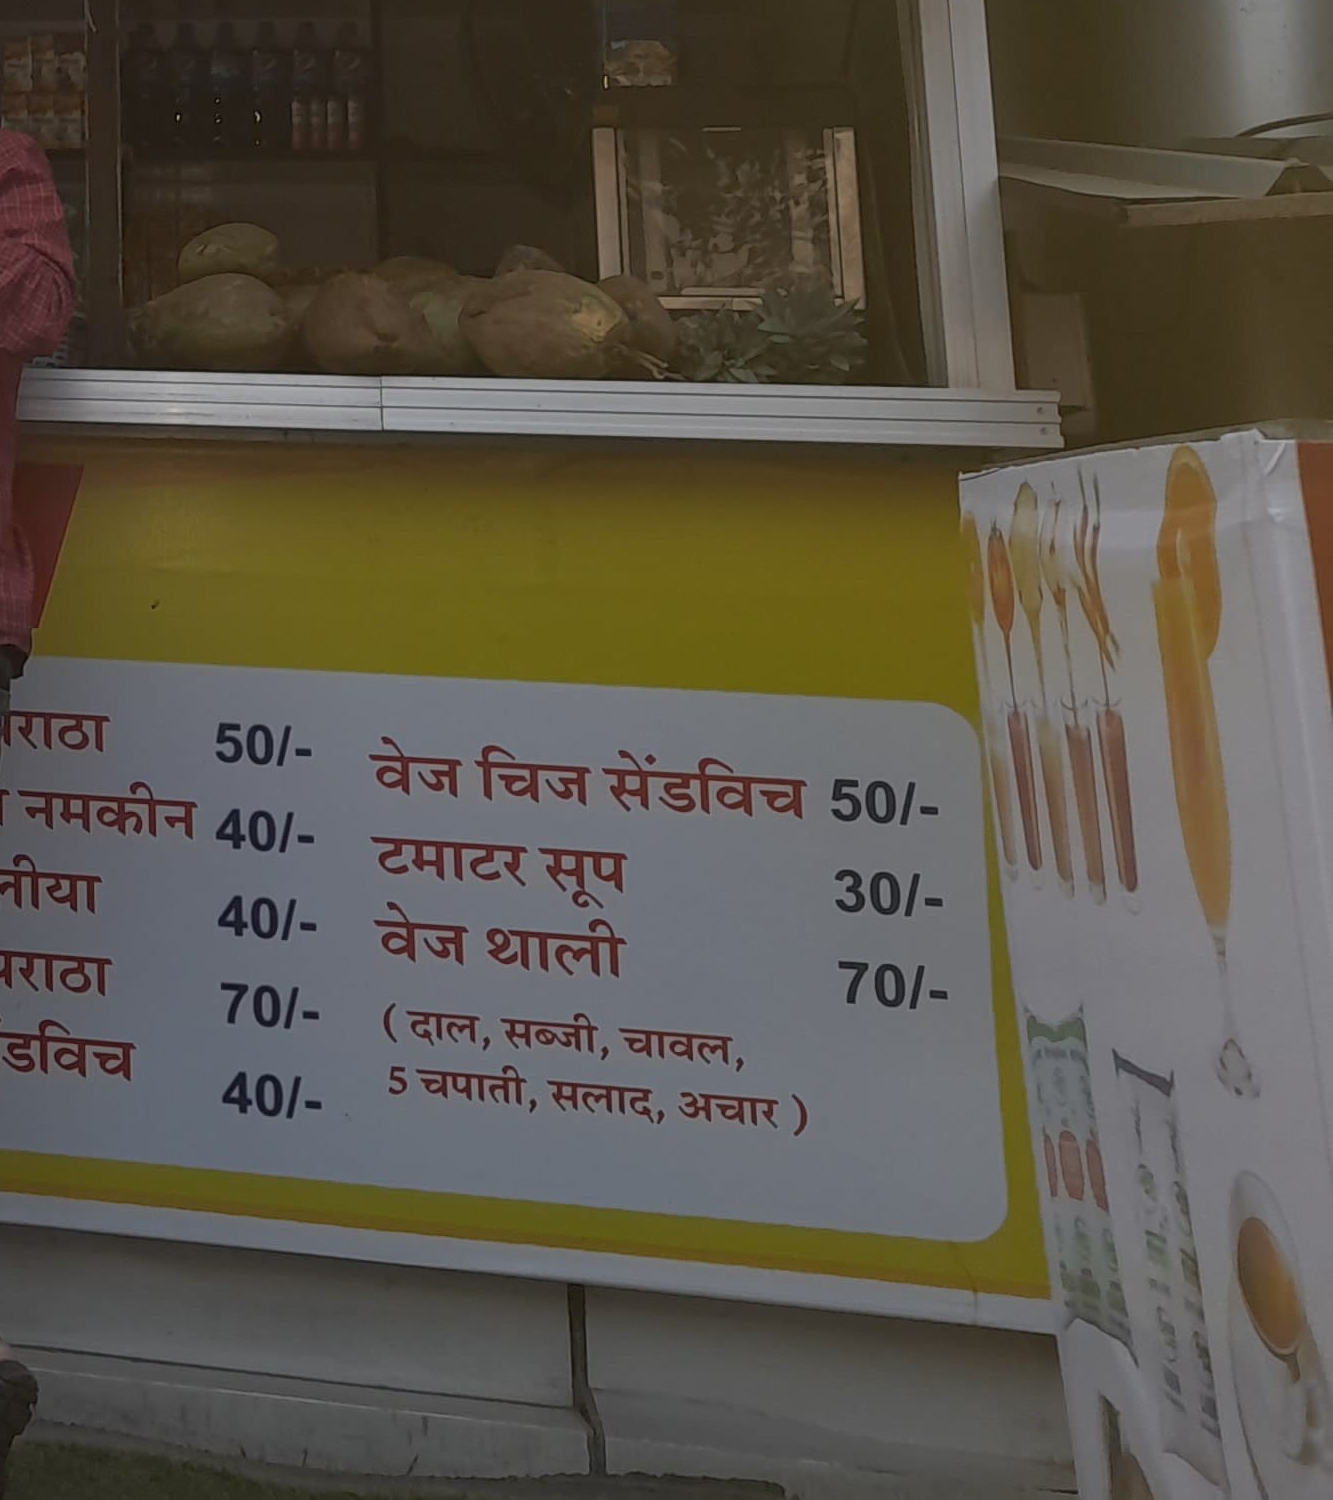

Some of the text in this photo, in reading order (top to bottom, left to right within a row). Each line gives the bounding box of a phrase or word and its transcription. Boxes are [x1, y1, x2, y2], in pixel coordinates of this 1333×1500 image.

[214, 721, 313, 767] 50/-
[368, 736, 940, 827] वेज चिज सेंडविच 50/-
[17, 781, 199, 841] नमकीन
[214, 807, 315, 854] 40/-
[369, 836, 944, 919] टमाटर सूप 30/-
[216, 894, 318, 942] 40/-
[374, 900, 950, 1011] वेज थाली 70/-
[219, 981, 321, 1031] 70/-
[406, 1009, 492, 1052] दाल,
[500, 1012, 609, 1060] सब्जी,
[618, 1026, 745, 1073] चावल,
[221, 1071, 323, 1119] 40/-
[387, 1066, 408, 1096] 5
[416, 1065, 538, 1114] चपाती,
[546, 1079, 666, 1126] सलाद,
[676, 1091, 781, 1130] अचार
